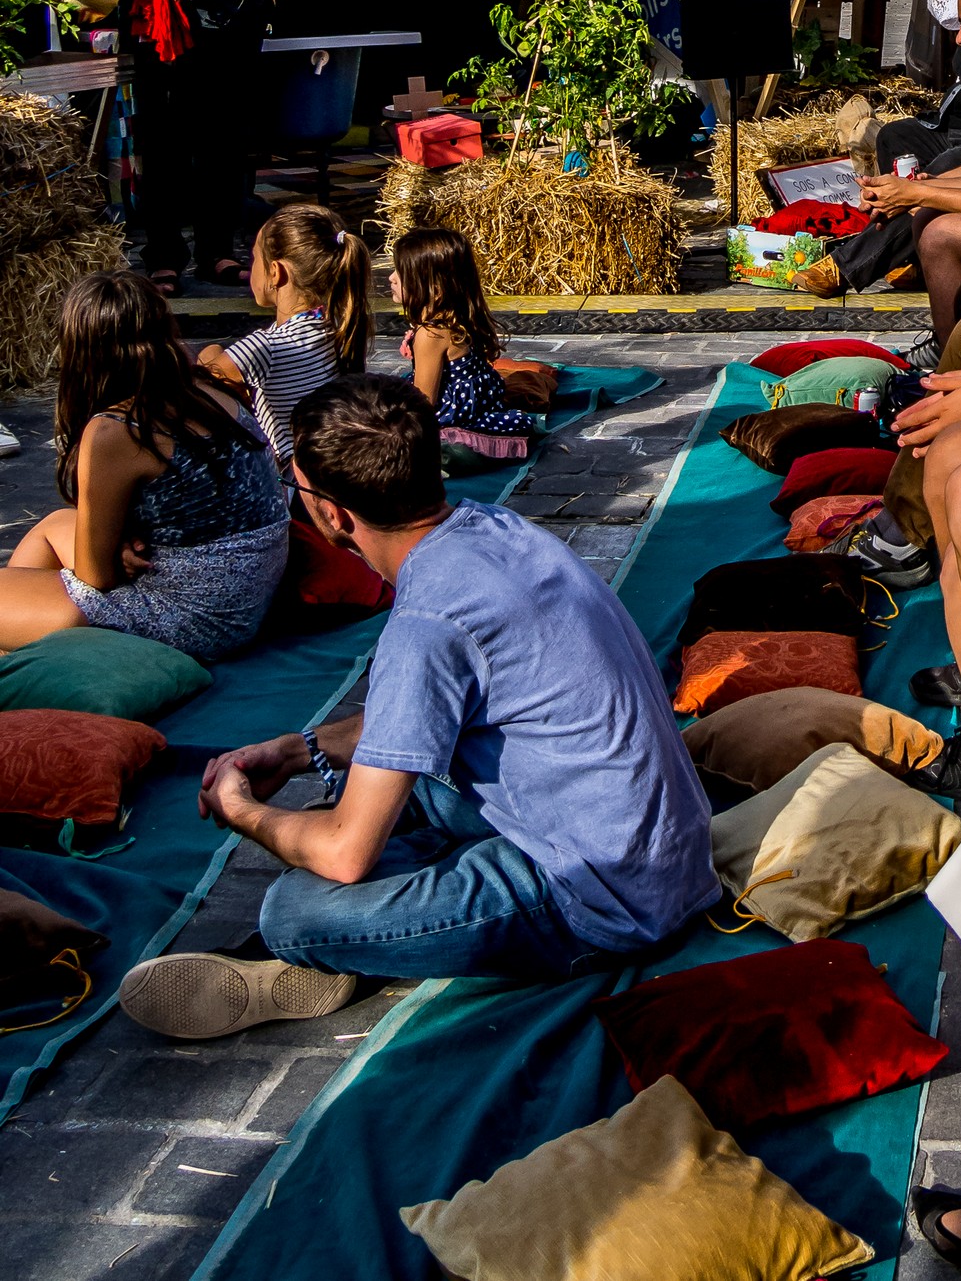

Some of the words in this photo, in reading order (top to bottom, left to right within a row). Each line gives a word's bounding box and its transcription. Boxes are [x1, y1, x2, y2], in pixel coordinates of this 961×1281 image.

[792, 178, 816, 193] SOIS
[821, 176, 831, 189] A
[822, 190, 853, 203] COMME
